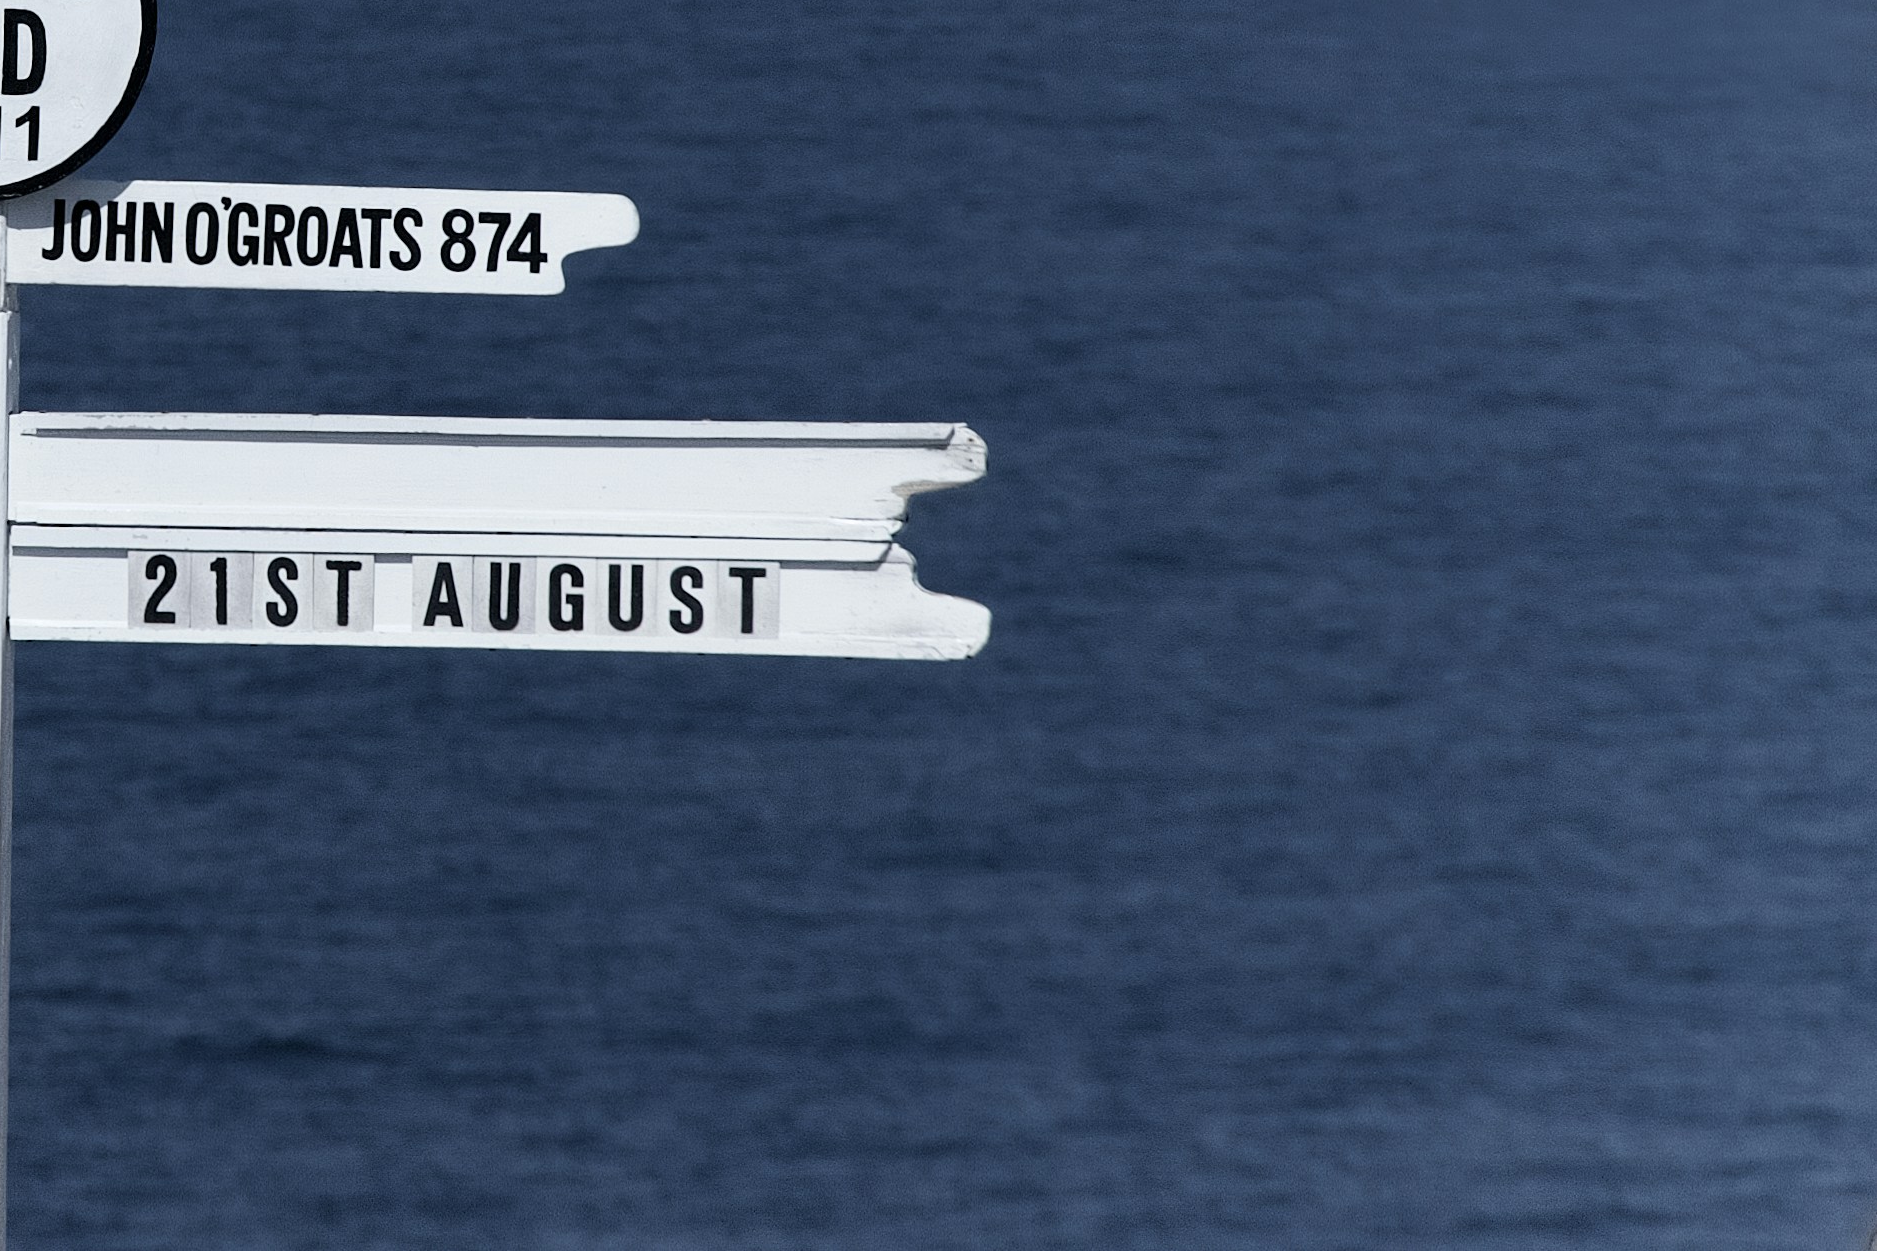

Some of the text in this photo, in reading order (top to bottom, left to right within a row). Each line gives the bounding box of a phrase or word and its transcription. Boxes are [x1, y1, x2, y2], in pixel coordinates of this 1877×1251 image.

[41, 196, 548, 274] JOHN O'GROATS 874
[143, 553, 767, 634] 21ST AUGUST
